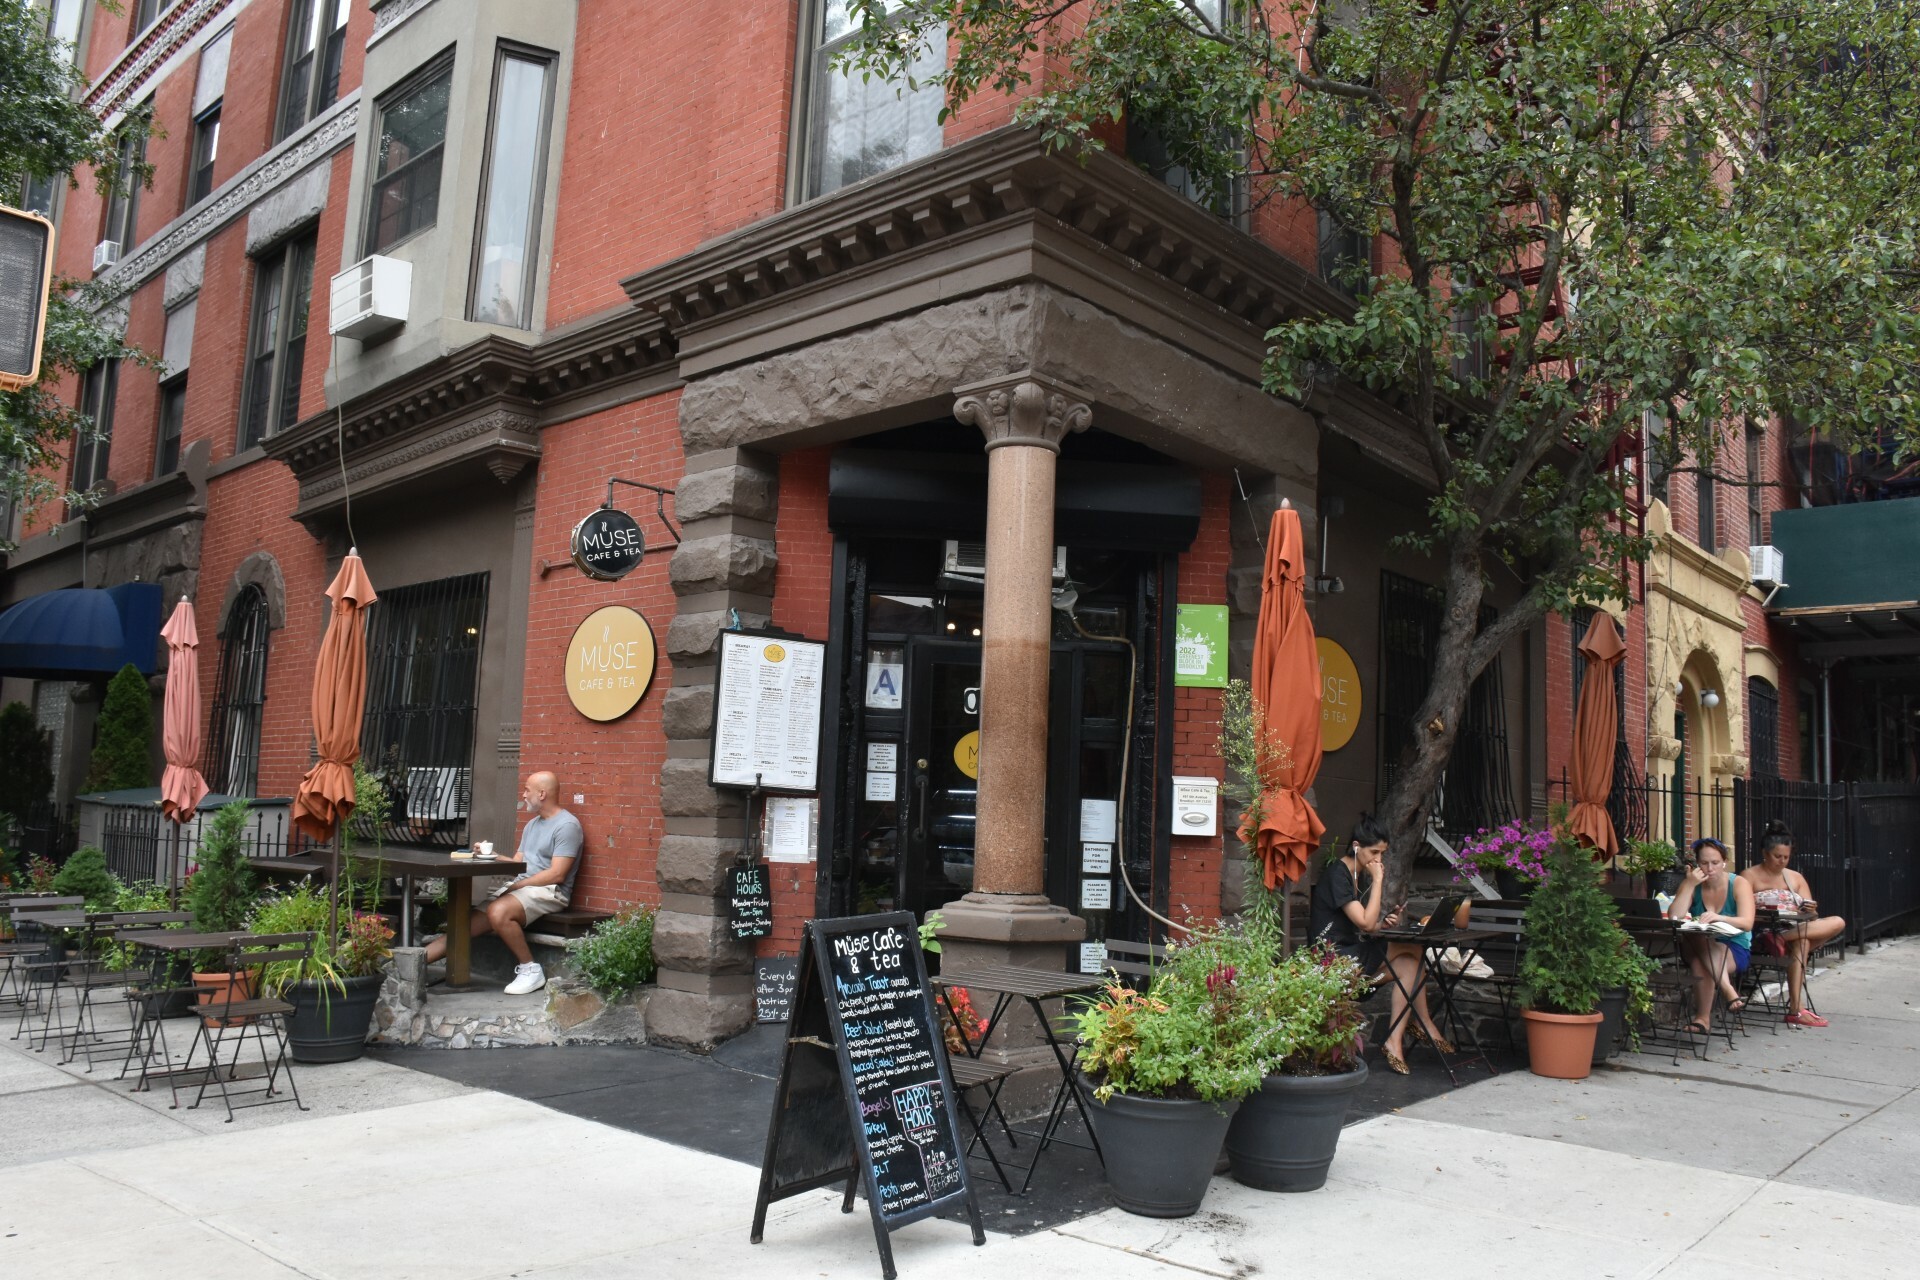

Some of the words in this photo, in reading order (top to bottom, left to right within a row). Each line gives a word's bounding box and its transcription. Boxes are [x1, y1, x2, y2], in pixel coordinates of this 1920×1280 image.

[586, 552, 611, 562] CAFE
[623, 548, 641, 557] TEA
[1179, 646, 1196, 654] 2022
[579, 678, 603, 691] CAFE
[607, 677, 614, 688] &
[618, 676, 635, 687] TEA
[872, 669, 896, 696] A
[1323, 709, 1329, 720] &
[1332, 710, 1347, 723] TEA
[736, 871, 760, 884] CAFE
[736, 883, 762, 895] HOURS
[872, 927, 904, 951] Cafe
[850, 956, 860, 973] &
[870, 951, 901, 971] tea
[760, 968, 785, 982] Every
[786, 971, 795, 980] da
[757, 982, 775, 994] after
[757, 997, 788, 1008] pastries
[758, 1009, 778, 1019] 25%
[844, 1020, 863, 1038] Beet
[896, 1084, 932, 1113] HAPPY
[860, 1097, 891, 1117] Bagels
[904, 1105, 936, 1130] HOUR
[864, 1122, 889, 1137] Turkey
[873, 1160, 889, 1178] BLT
[926, 1165, 944, 1179] WINE
